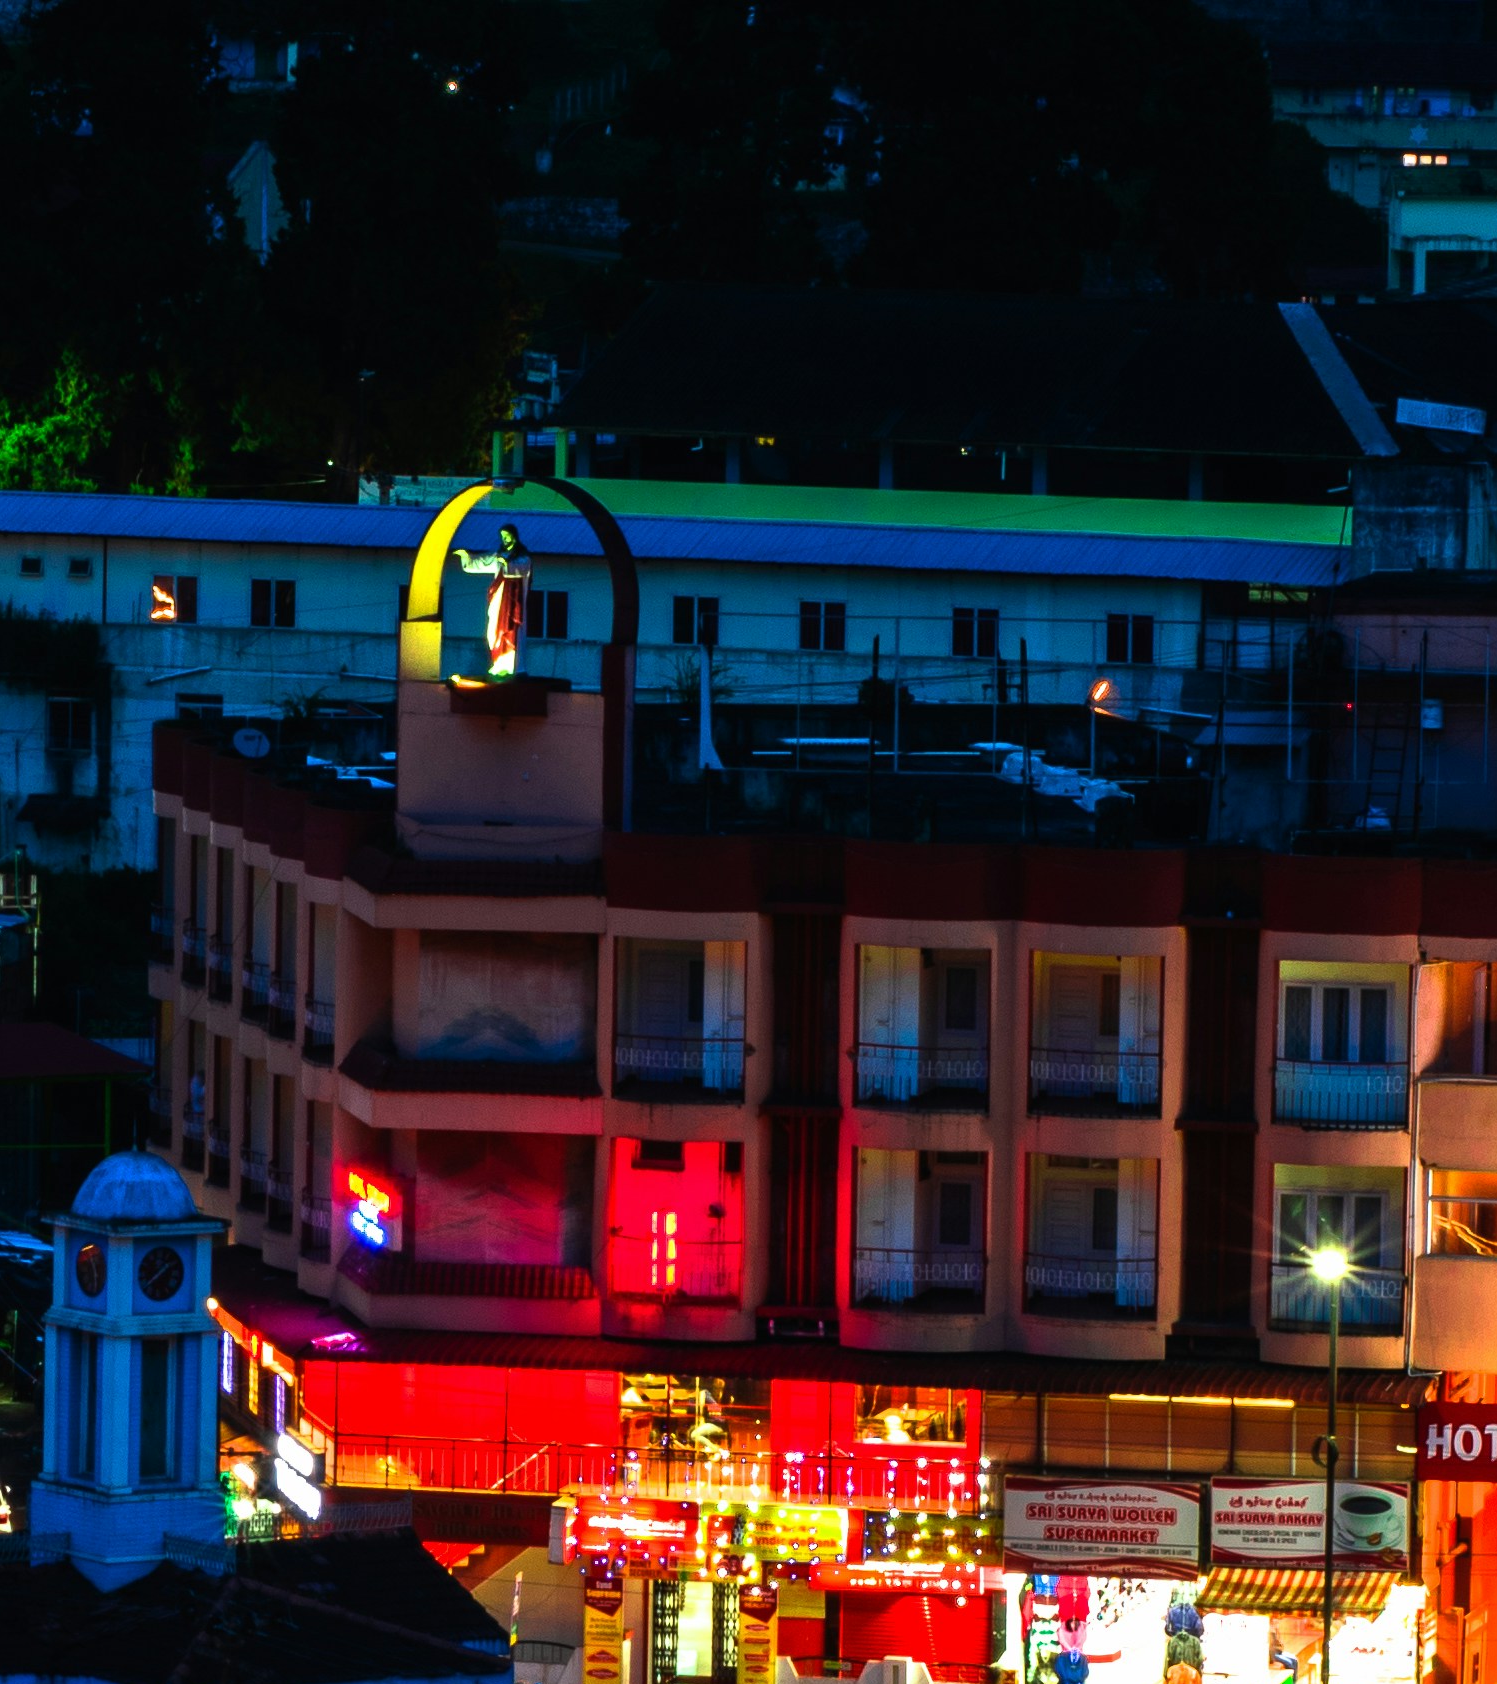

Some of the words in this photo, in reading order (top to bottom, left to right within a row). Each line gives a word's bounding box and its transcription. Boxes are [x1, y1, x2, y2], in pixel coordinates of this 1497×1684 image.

[1025, 1503, 1054, 1521] SRI
[1056, 1504, 1109, 1522] SURYA
[1110, 1506, 1177, 1525] WOLLEN
[1215, 1512, 1235, 1524] SRI
[1236, 1512, 1276, 1525] SURYA
[1277, 1512, 1324, 1527] BAKERY
[1044, 1524, 1159, 1545] SUPERMARKET
